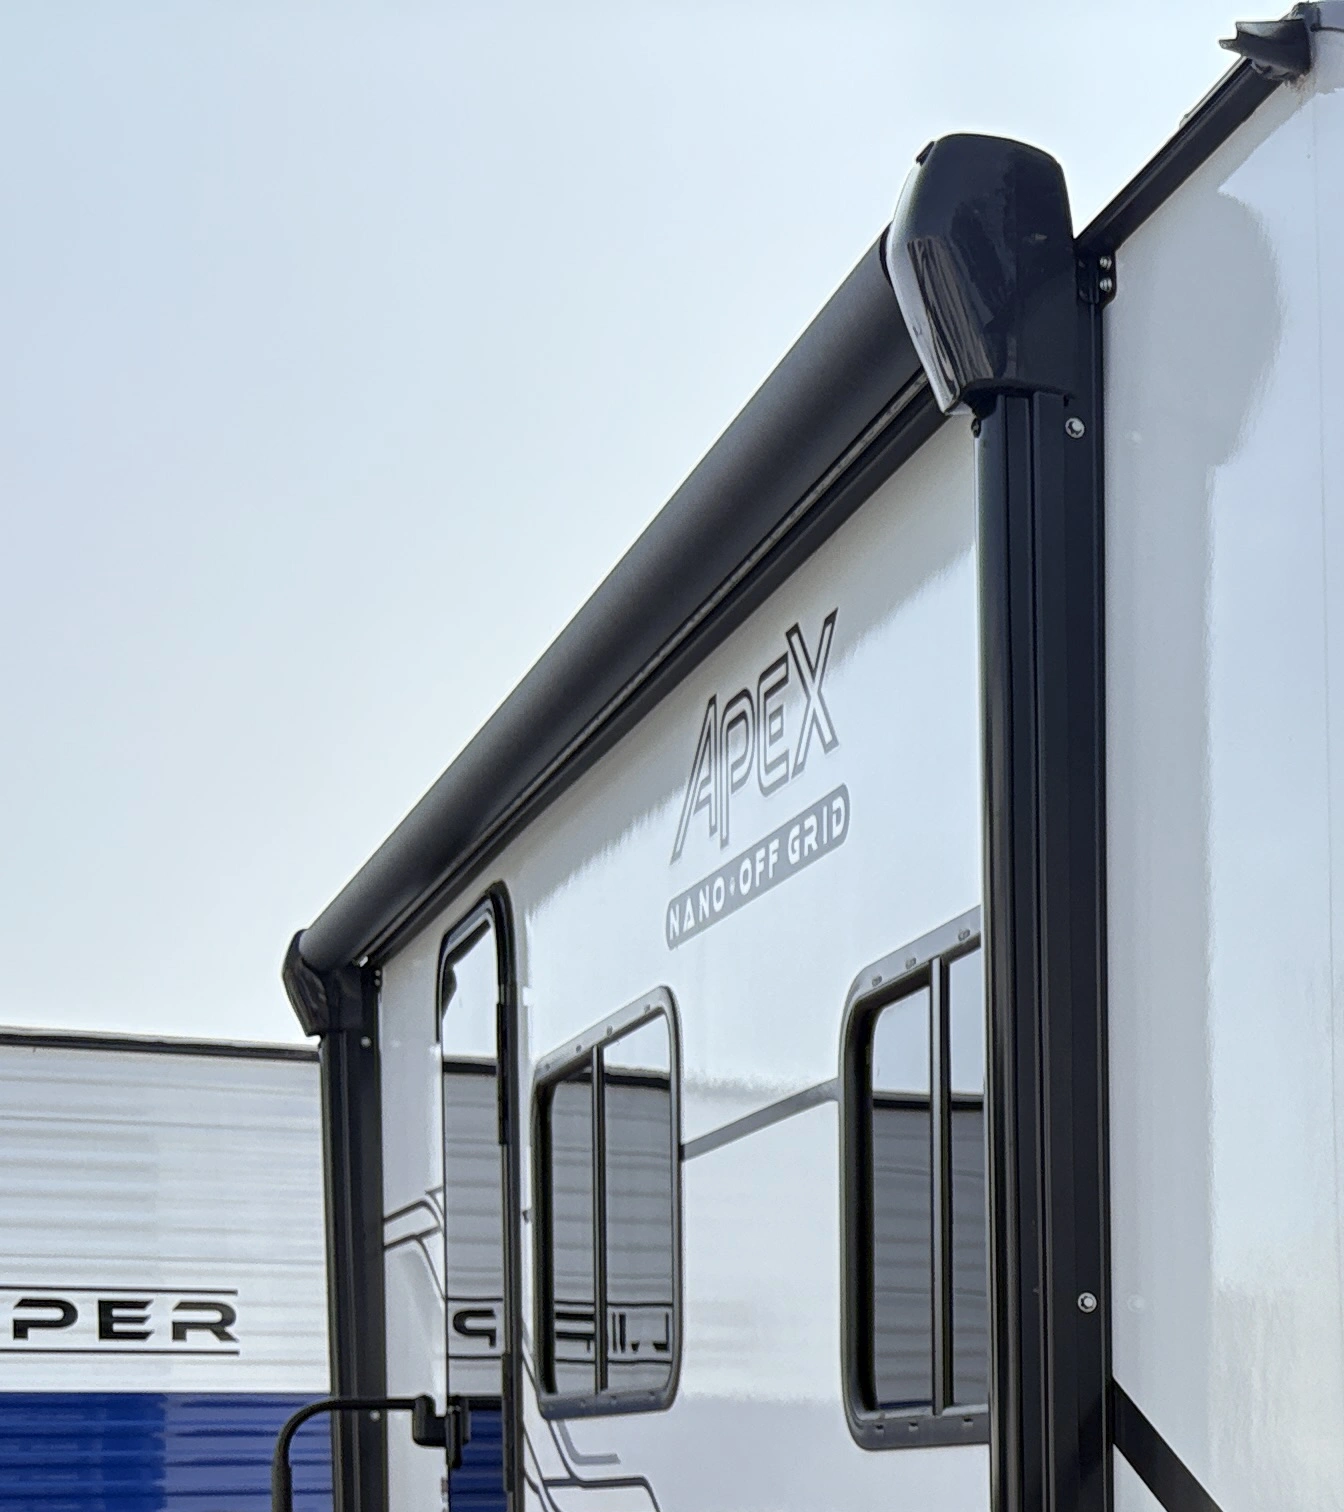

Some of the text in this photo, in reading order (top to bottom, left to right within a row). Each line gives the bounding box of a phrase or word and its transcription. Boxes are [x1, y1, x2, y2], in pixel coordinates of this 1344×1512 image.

[669, 607, 839, 866] APEX
[668, 793, 847, 942] NANO OFF GRID
[11, 1299, 240, 1343] PER
